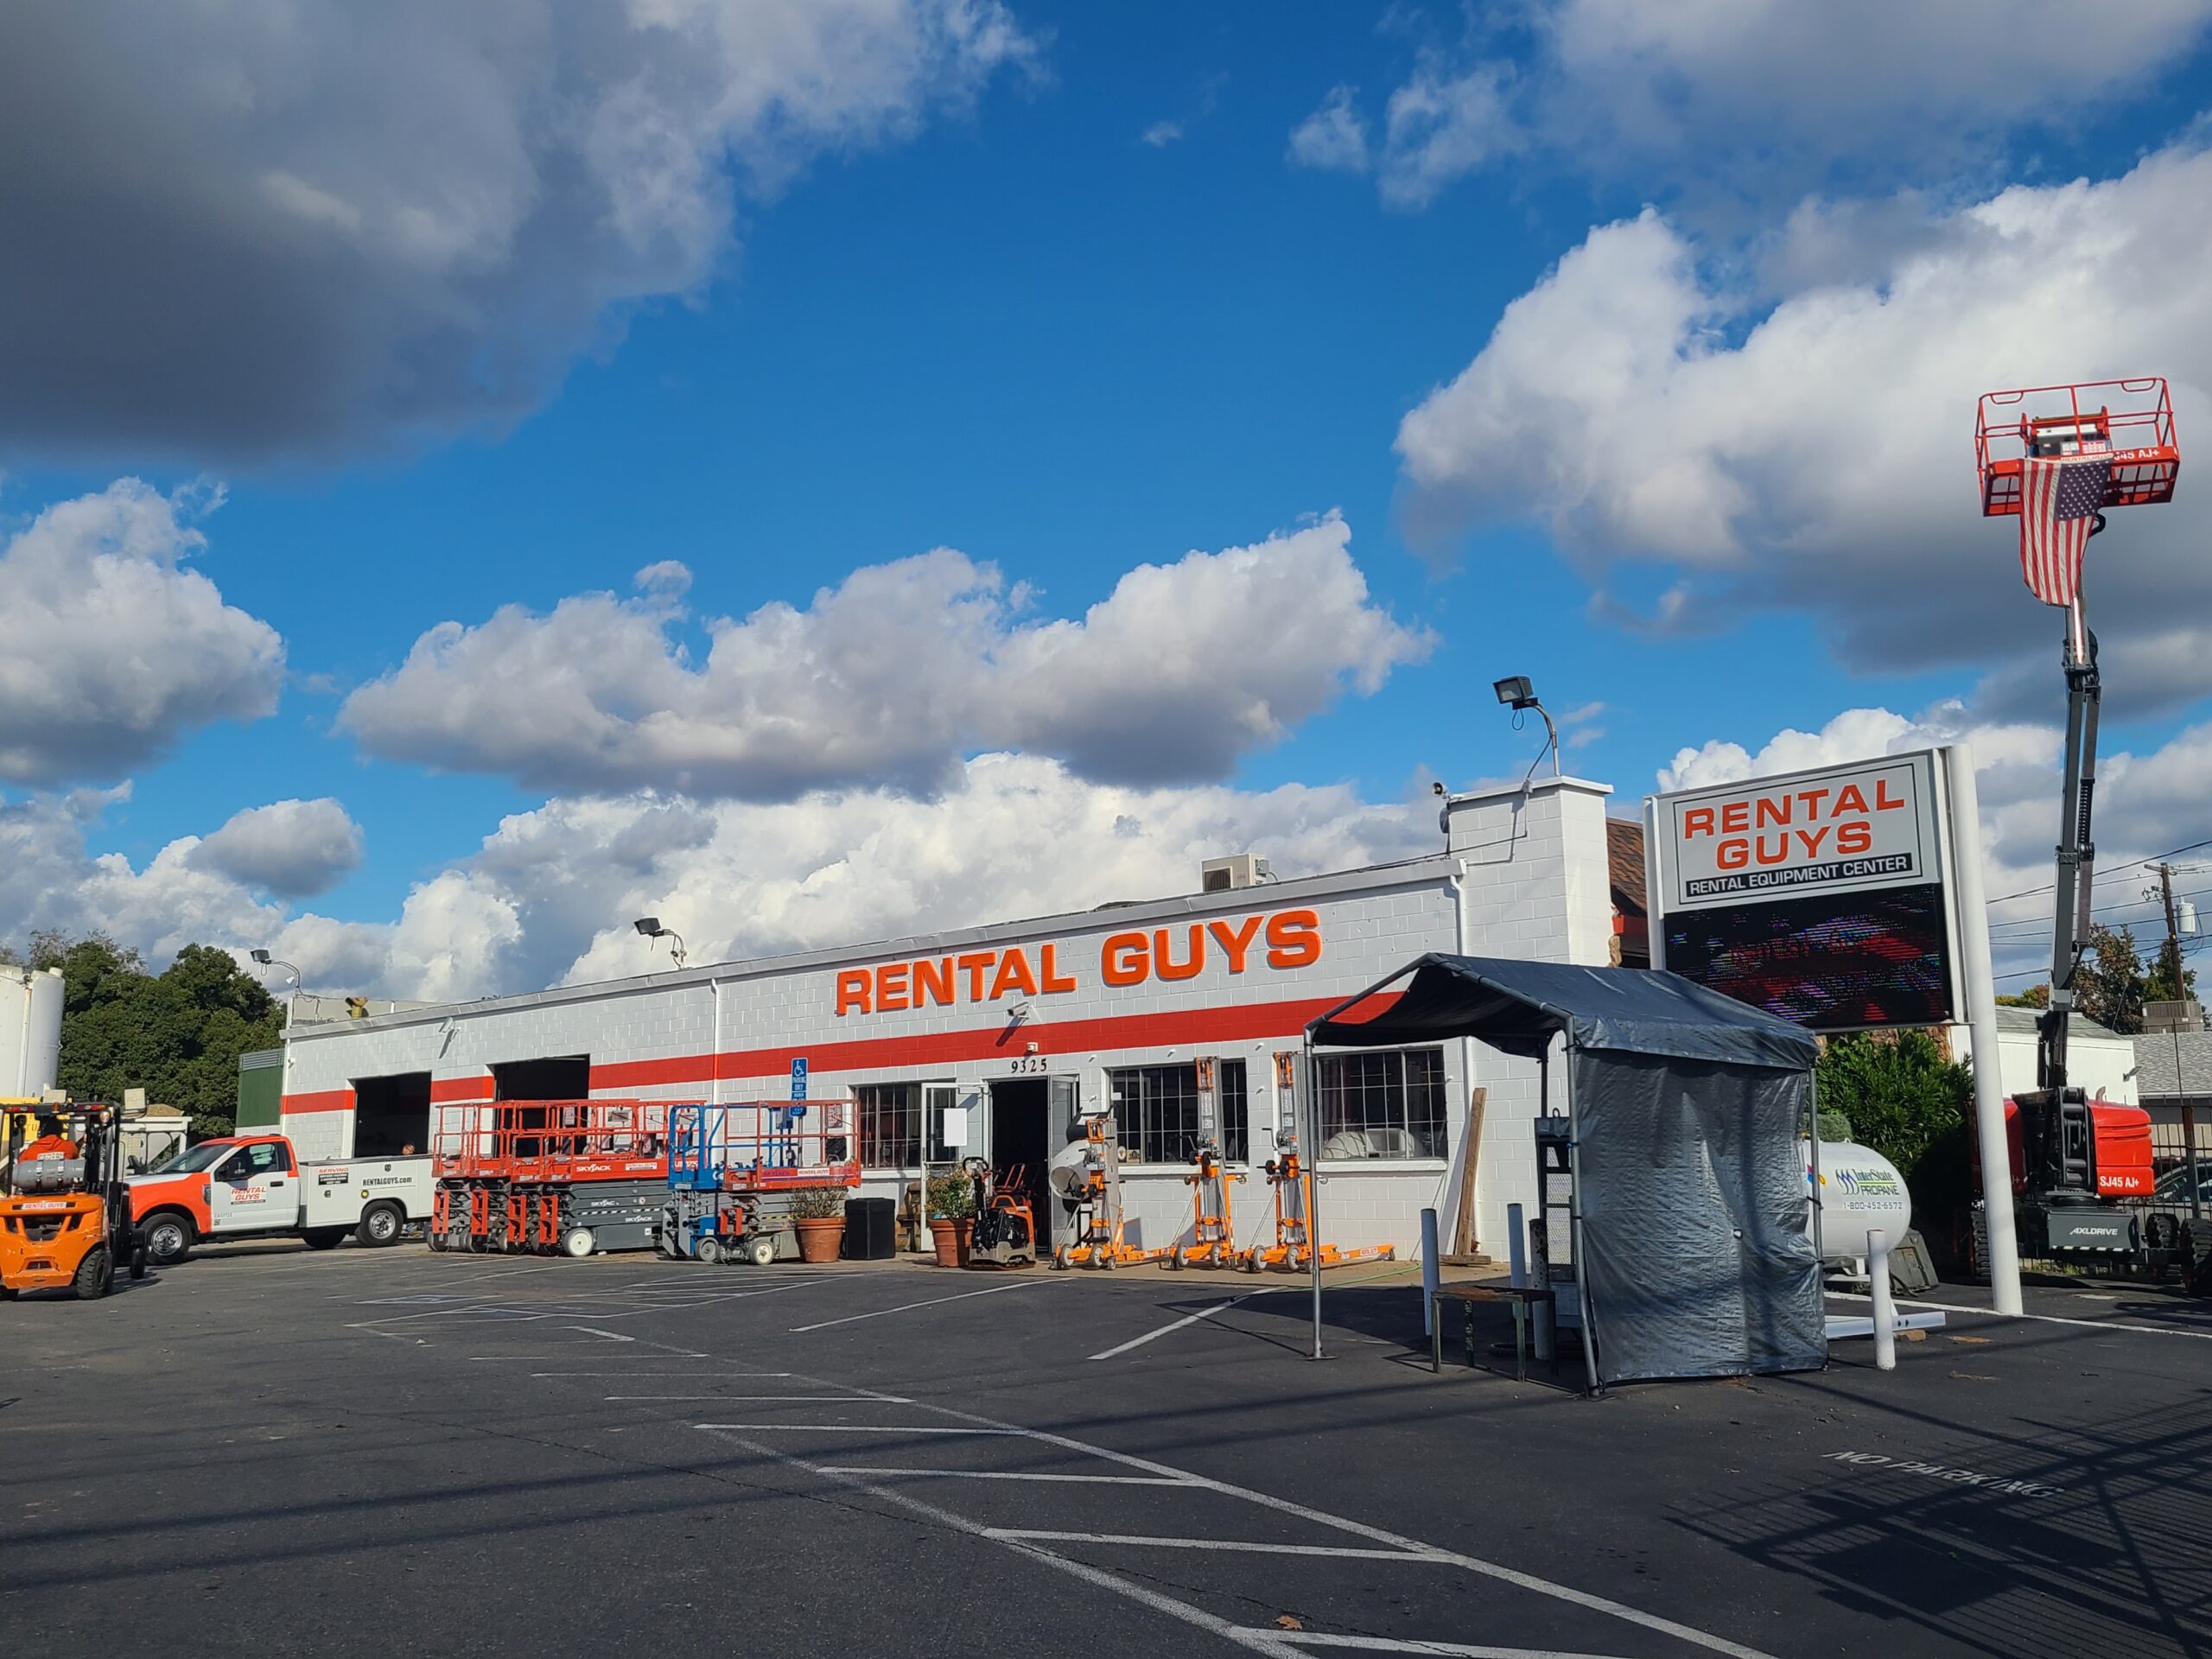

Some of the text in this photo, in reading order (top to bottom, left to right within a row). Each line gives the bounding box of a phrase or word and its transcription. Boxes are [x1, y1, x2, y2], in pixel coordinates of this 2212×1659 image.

[2138, 448, 2160, 459] AJ+
[1684, 779, 1905, 839] RENTAL
[1716, 821, 1872, 871] GUYS
[1689, 856, 1908, 895] RENTAL EQUIPMENT CENTER
[836, 910, 1322, 1015] RENTAL GUYS
[1011, 1058, 1047, 1073] 9325
[576, 1163, 612, 1173] SKYJACK
[363, 1177, 412, 1186] RENTALGUYS.com
[2100, 1175, 2139, 1188] SJ45 AJ+
[1860, 1185, 1899, 1195] PROPANE
[2069, 1227, 2118, 1236] AXLDRIVE
[1821, 1451, 2065, 1497] NO PARKING
